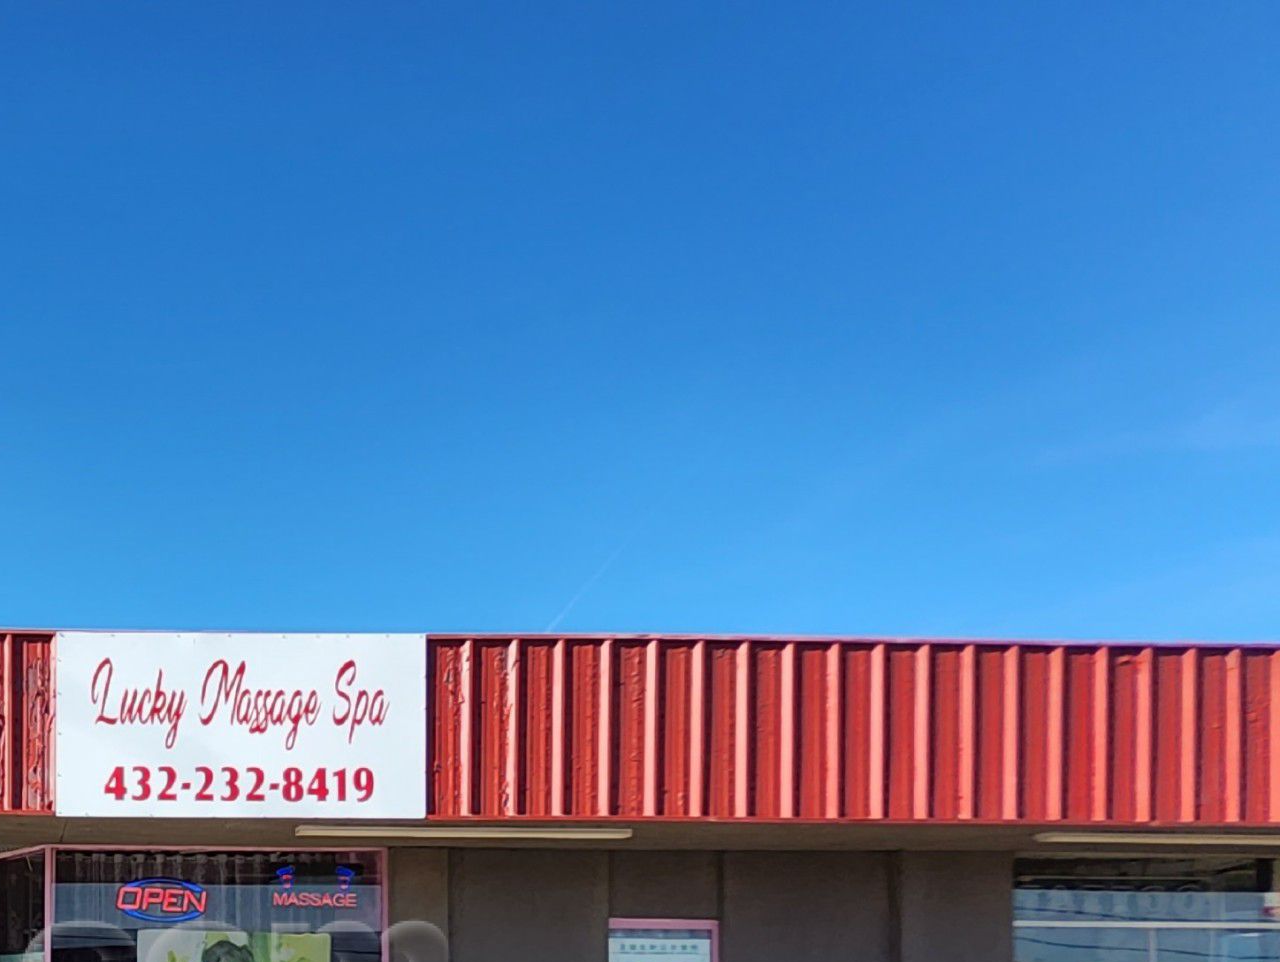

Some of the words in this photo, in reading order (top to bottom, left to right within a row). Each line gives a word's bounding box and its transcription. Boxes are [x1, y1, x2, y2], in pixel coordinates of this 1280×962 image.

[90, 657, 187, 750] Lucky
[198, 659, 322, 751] Massage
[332, 659, 390, 744] Spa
[103, 766, 375, 803] 432-232-8419
[117, 886, 207, 913] OPEN
[272, 892, 357, 908] MASSAGE
